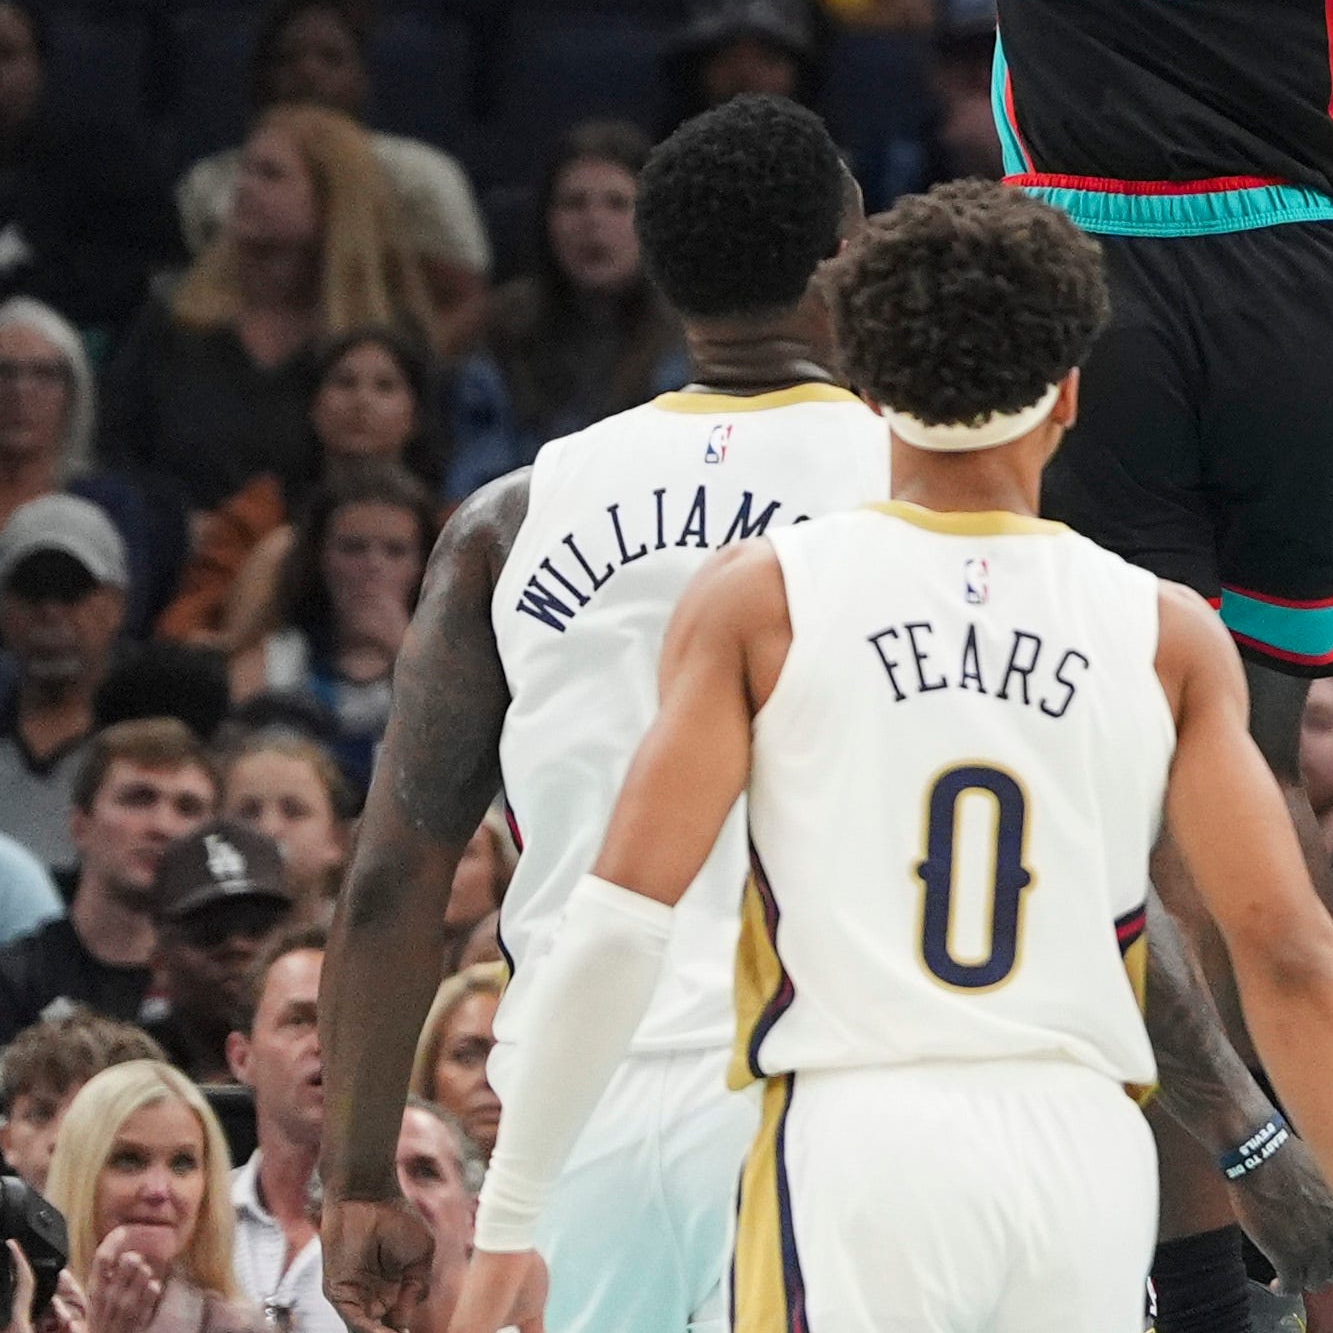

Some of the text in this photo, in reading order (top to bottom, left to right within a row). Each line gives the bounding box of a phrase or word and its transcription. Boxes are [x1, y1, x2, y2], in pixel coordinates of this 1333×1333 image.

[516, 485, 811, 633] WILLIAM
[867, 622, 1089, 718] FEARS
[914, 758, 1037, 995] 0
